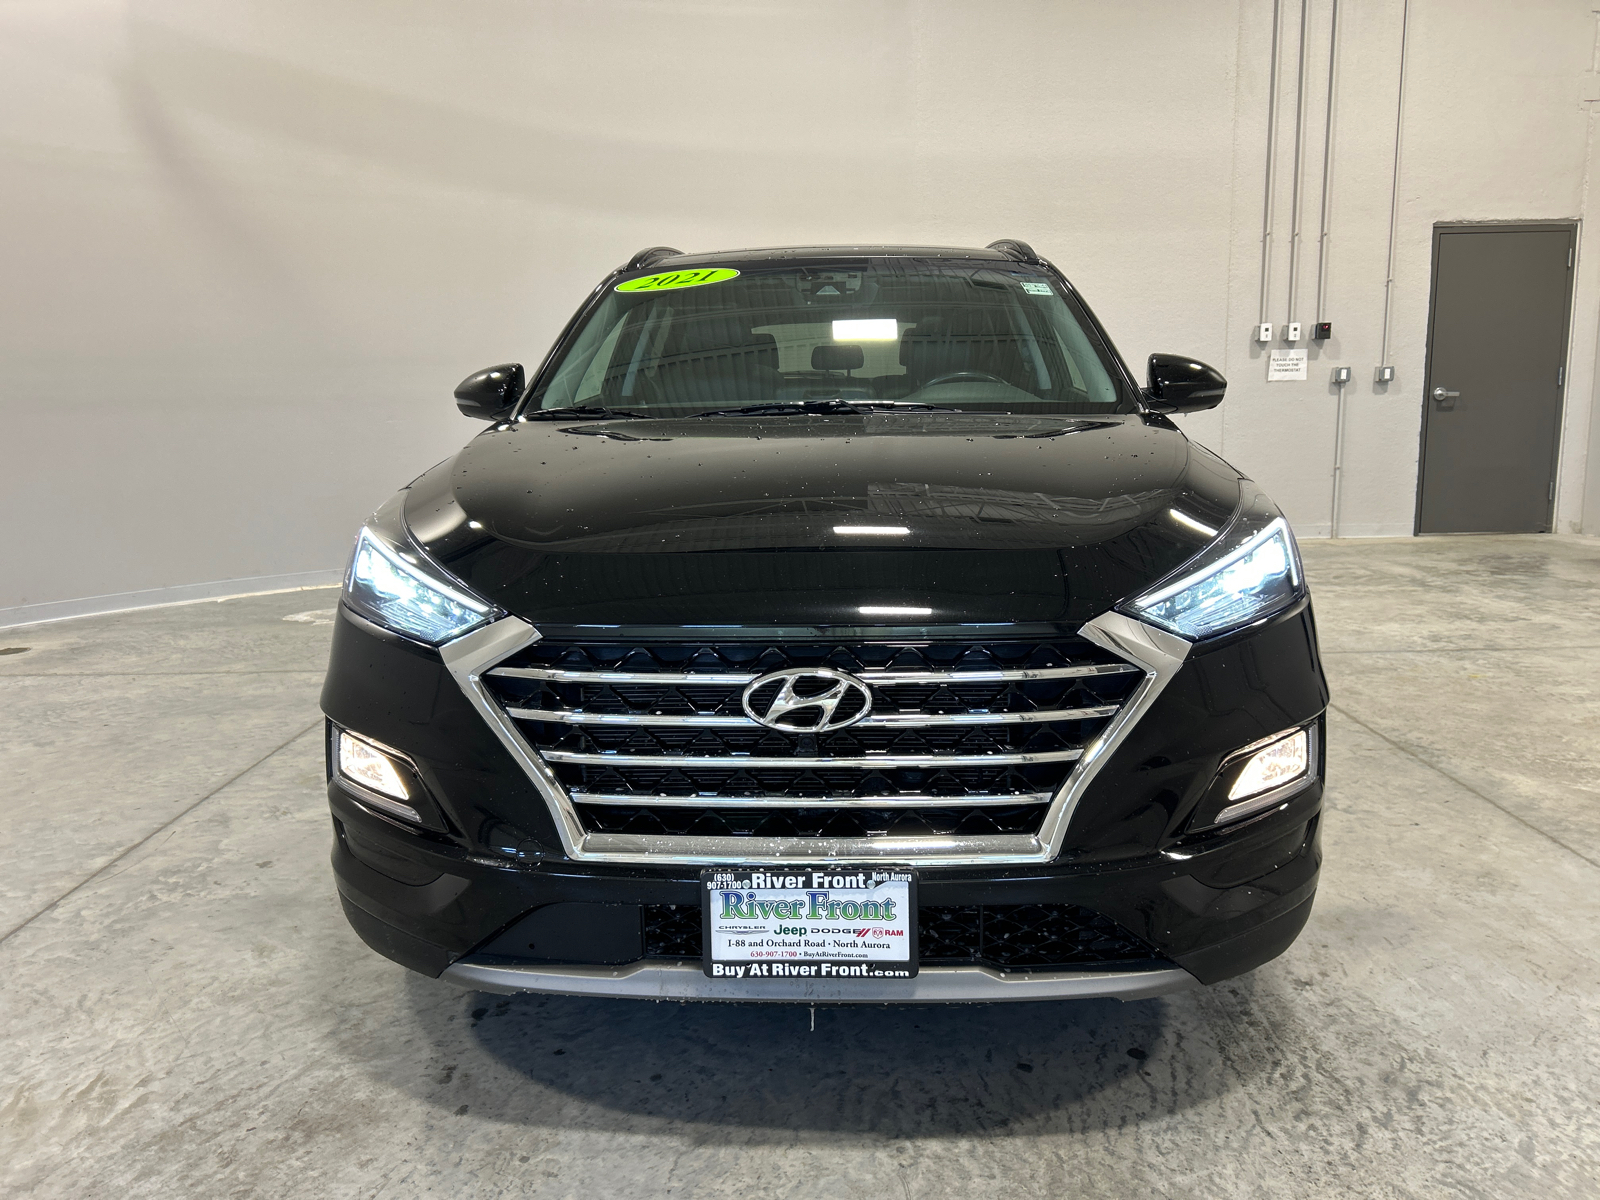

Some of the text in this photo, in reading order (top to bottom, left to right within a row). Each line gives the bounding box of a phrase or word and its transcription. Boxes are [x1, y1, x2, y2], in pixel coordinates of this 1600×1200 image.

[634, 269, 719, 290] 2021
[714, 873, 735, 882] (630)
[751, 872, 866, 889] River Front
[871, 871, 912, 882] North Aurora
[706, 881, 742, 890] 907-1700
[719, 890, 897, 921] River Front
[773, 924, 808, 937] Jeep
[884, 929, 904, 937] RAM
[728, 939, 891, 949] I-88 and Orchard Road North Aurora
[750, 950, 798, 958] 630-907-1700
[712, 963, 910, 978] Buy At River Front.com
